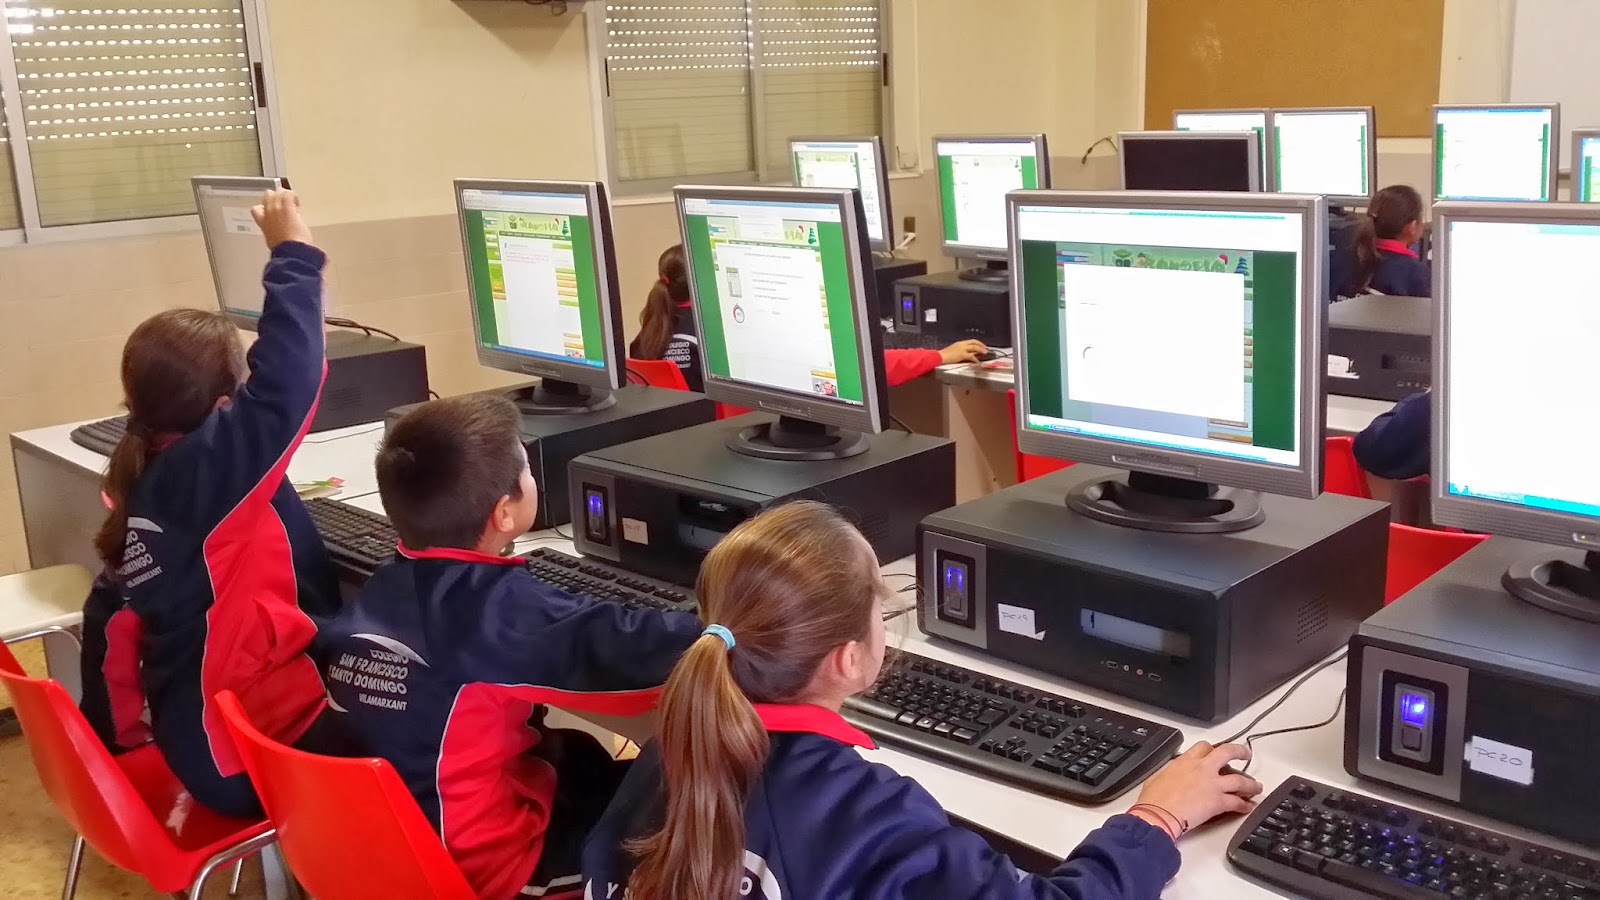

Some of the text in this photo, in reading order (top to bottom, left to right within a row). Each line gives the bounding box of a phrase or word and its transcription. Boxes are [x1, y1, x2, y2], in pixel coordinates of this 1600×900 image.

[339, 653, 408, 680] SAN FRANCISCO
[369, 649, 409, 664] COLEGIO
[331, 665, 354, 685] SANTO
[354, 673, 408, 695] DOMINGO
[359, 693, 408, 711] VILAMARXANT
